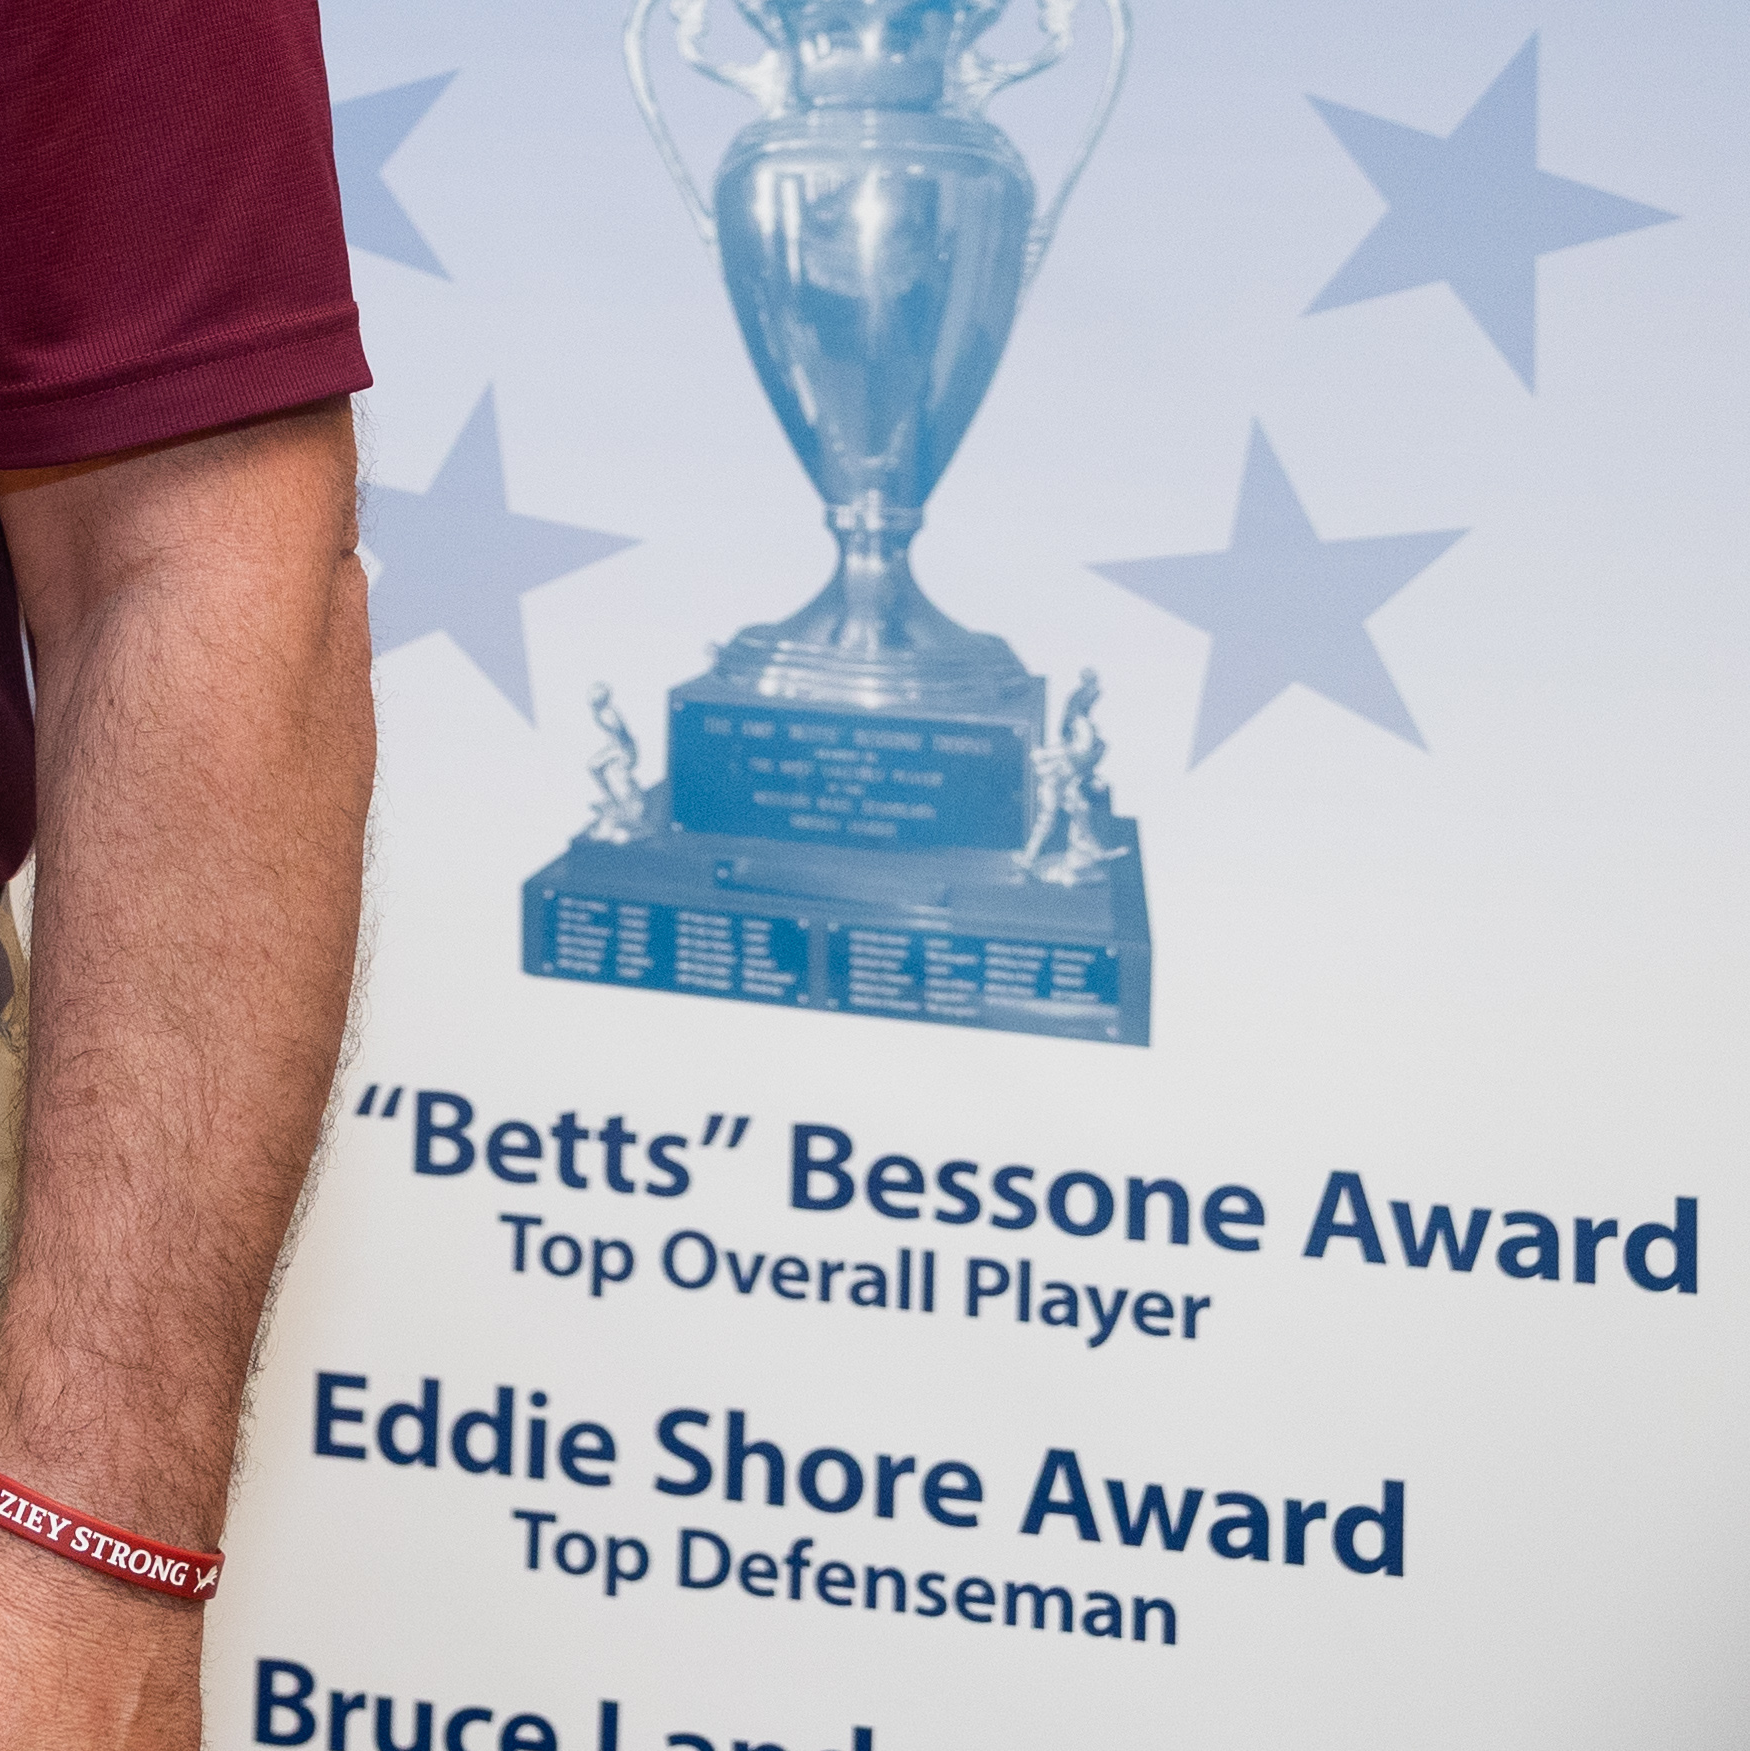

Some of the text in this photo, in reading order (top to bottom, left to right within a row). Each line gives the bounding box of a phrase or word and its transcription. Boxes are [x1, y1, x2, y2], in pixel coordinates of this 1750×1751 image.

[790, 1124, 1265, 1252] Bessone
[1303, 1171, 1697, 1294] Award
[500, 1214, 1210, 1348] Top Overall Player
[314, 1372, 1404, 1577] Eddie Shore Award
[70, 1527, 189, 1587] STRONG
[513, 1510, 1179, 1645] Top Defenseman
